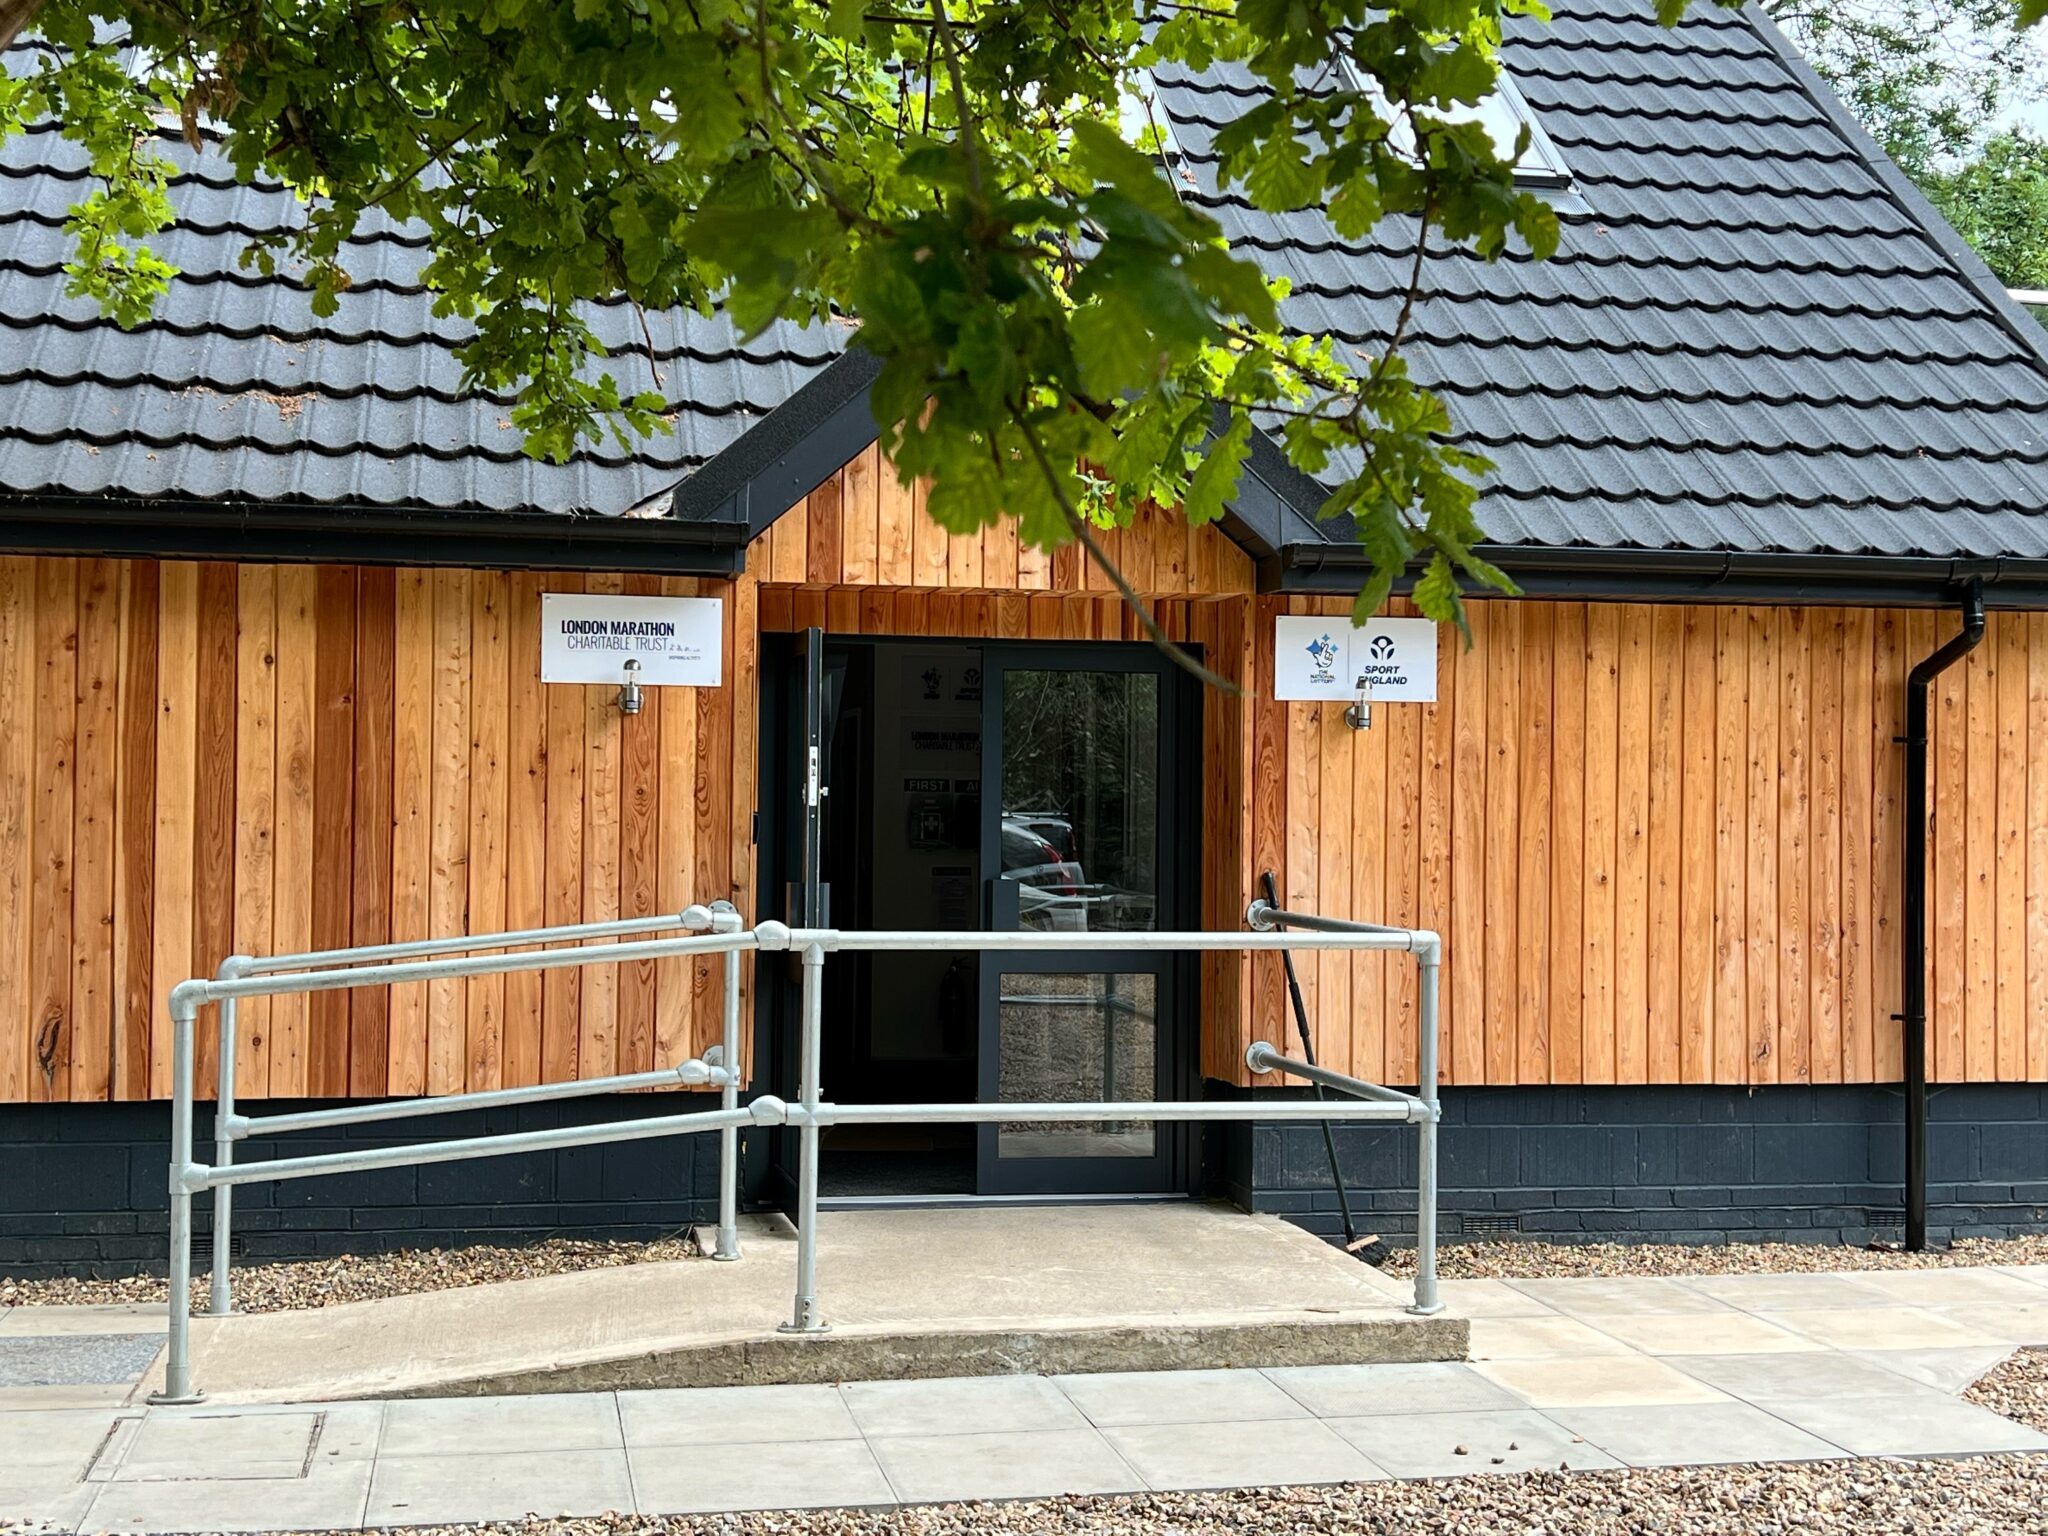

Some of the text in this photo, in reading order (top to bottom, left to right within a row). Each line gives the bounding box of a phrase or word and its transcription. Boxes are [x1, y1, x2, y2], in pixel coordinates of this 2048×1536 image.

[561, 620, 675, 636] LONDON MARATHON
[567, 635, 669, 651] CHARITABLE TRUST
[1364, 665, 1400, 674] SPORT
[909, 780, 945, 791] FIRST
